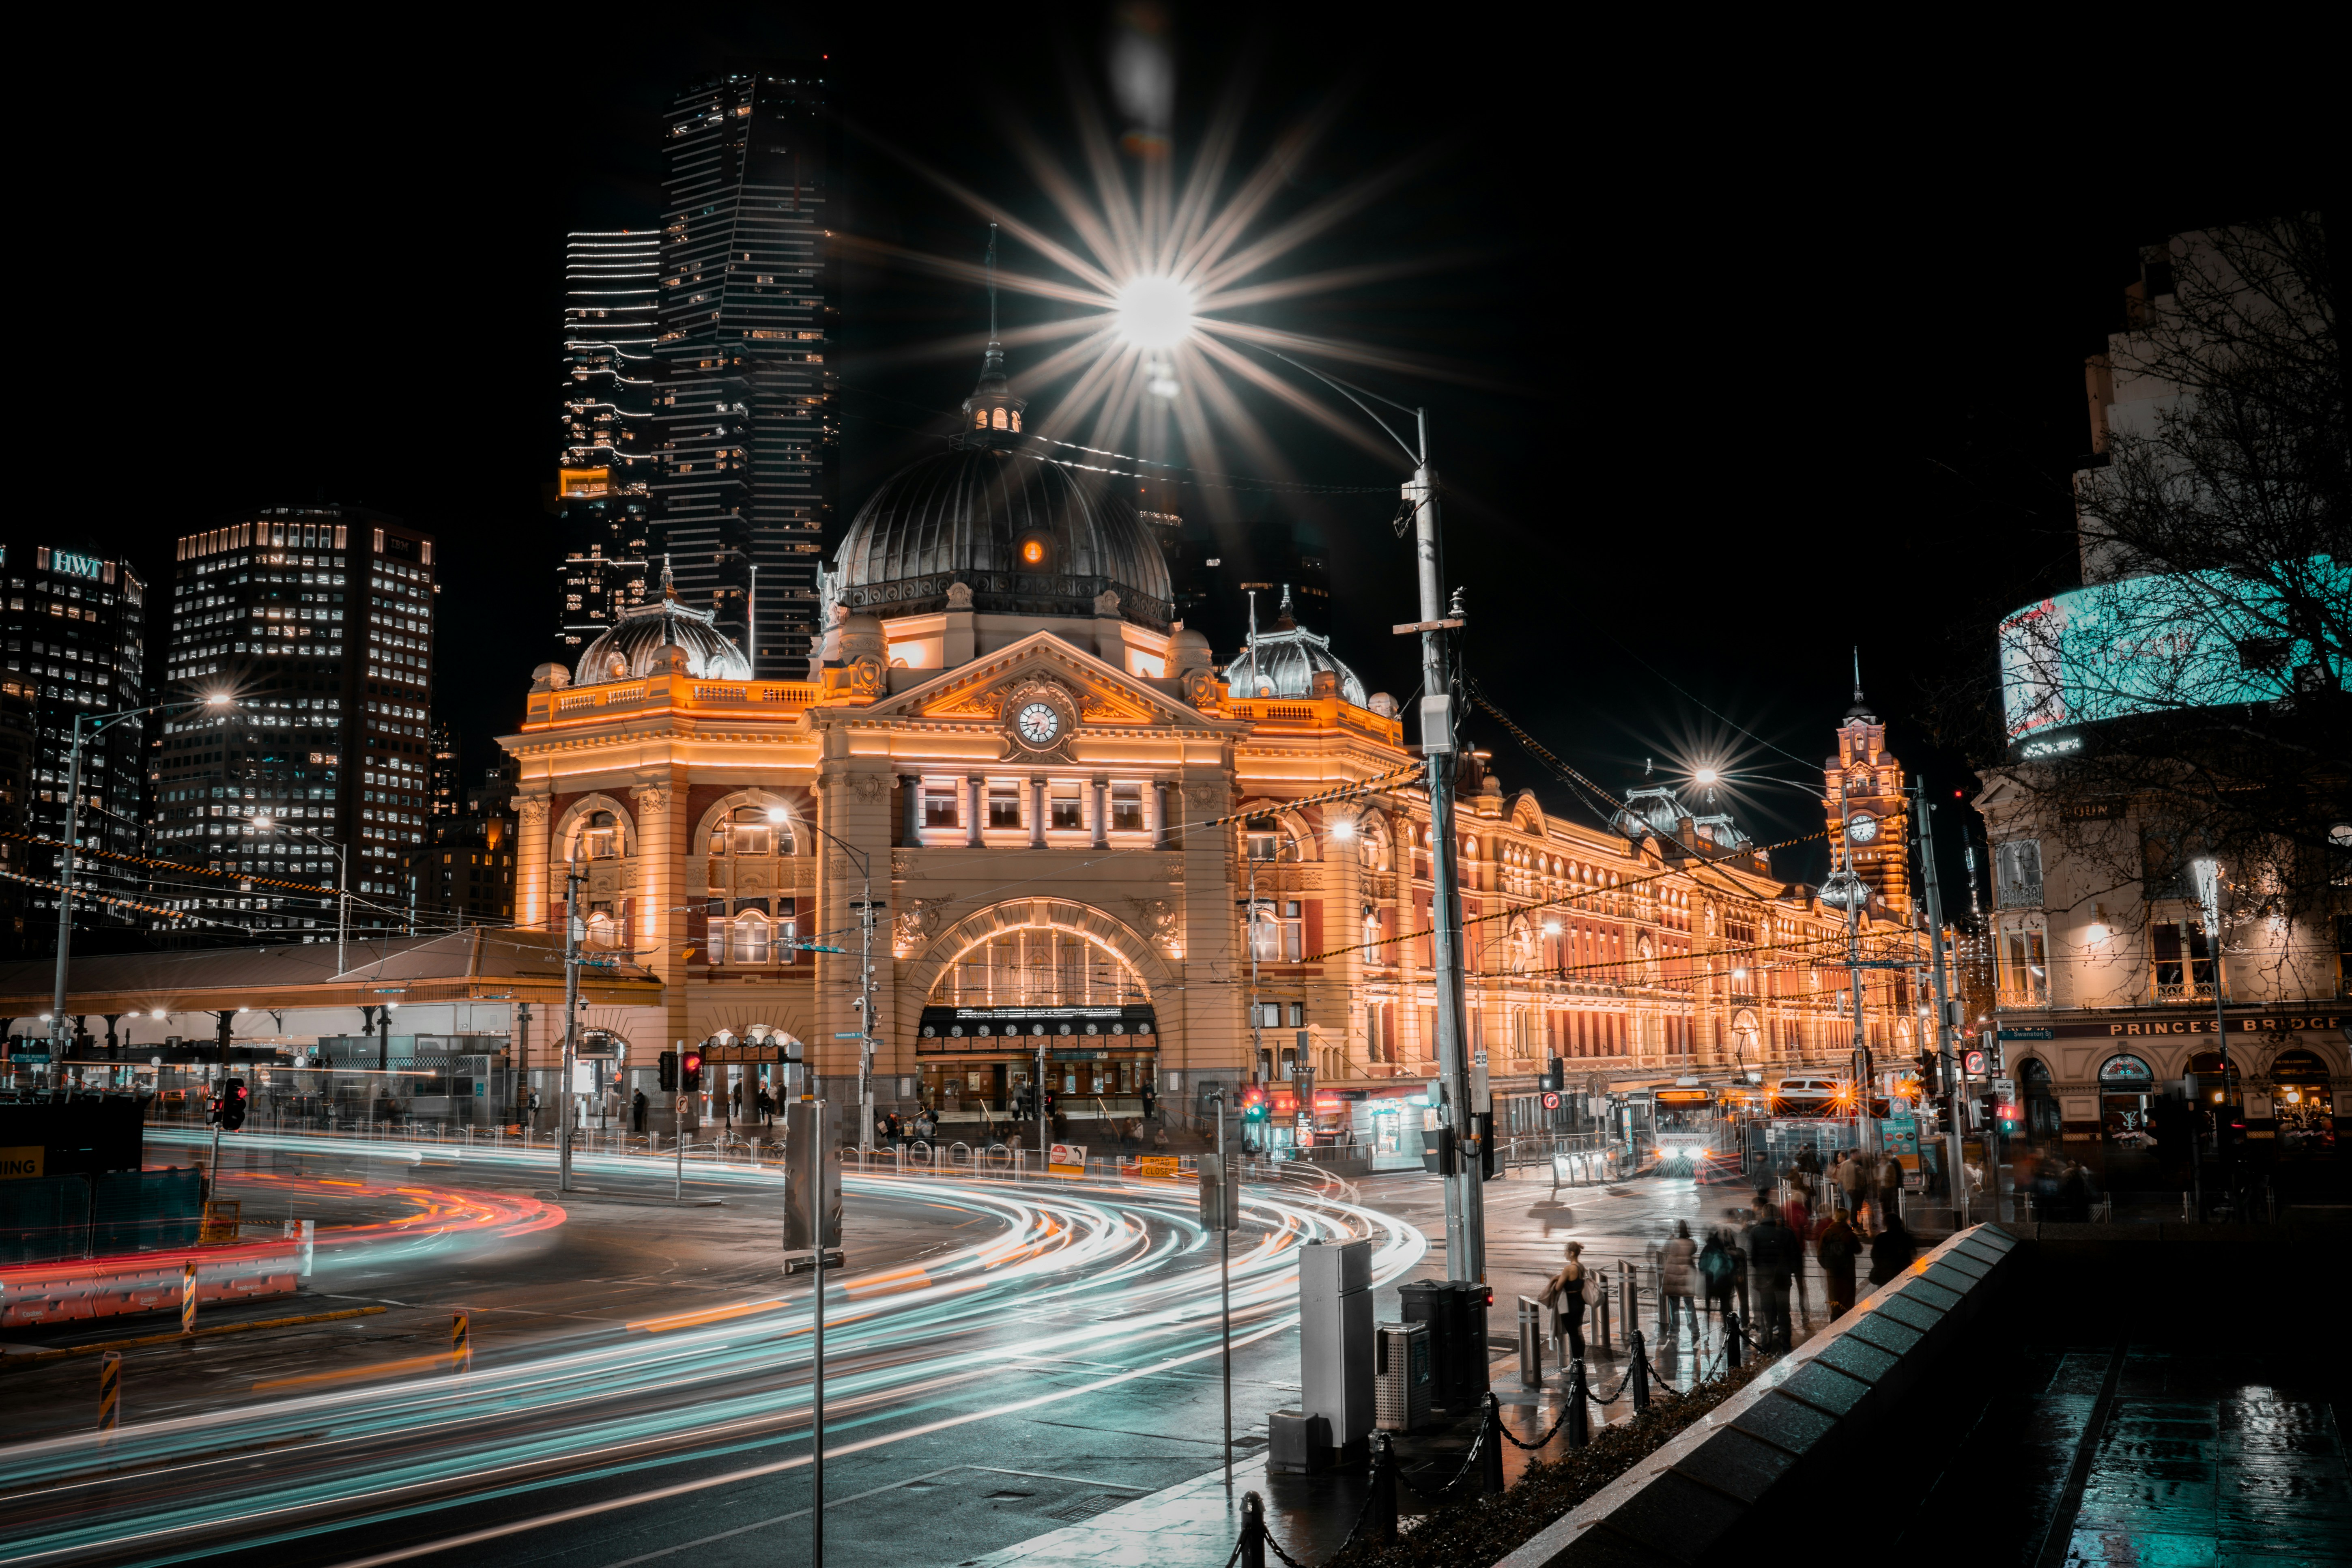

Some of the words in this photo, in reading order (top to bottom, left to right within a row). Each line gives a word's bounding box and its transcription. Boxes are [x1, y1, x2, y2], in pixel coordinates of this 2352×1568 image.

[54, 552, 103, 578] HWT
[2111, 1021, 2219, 1035] PRINCE'S
[2243, 1017, 2339, 1031] BRIDGE
[0, 1159, 35, 1175] ING
